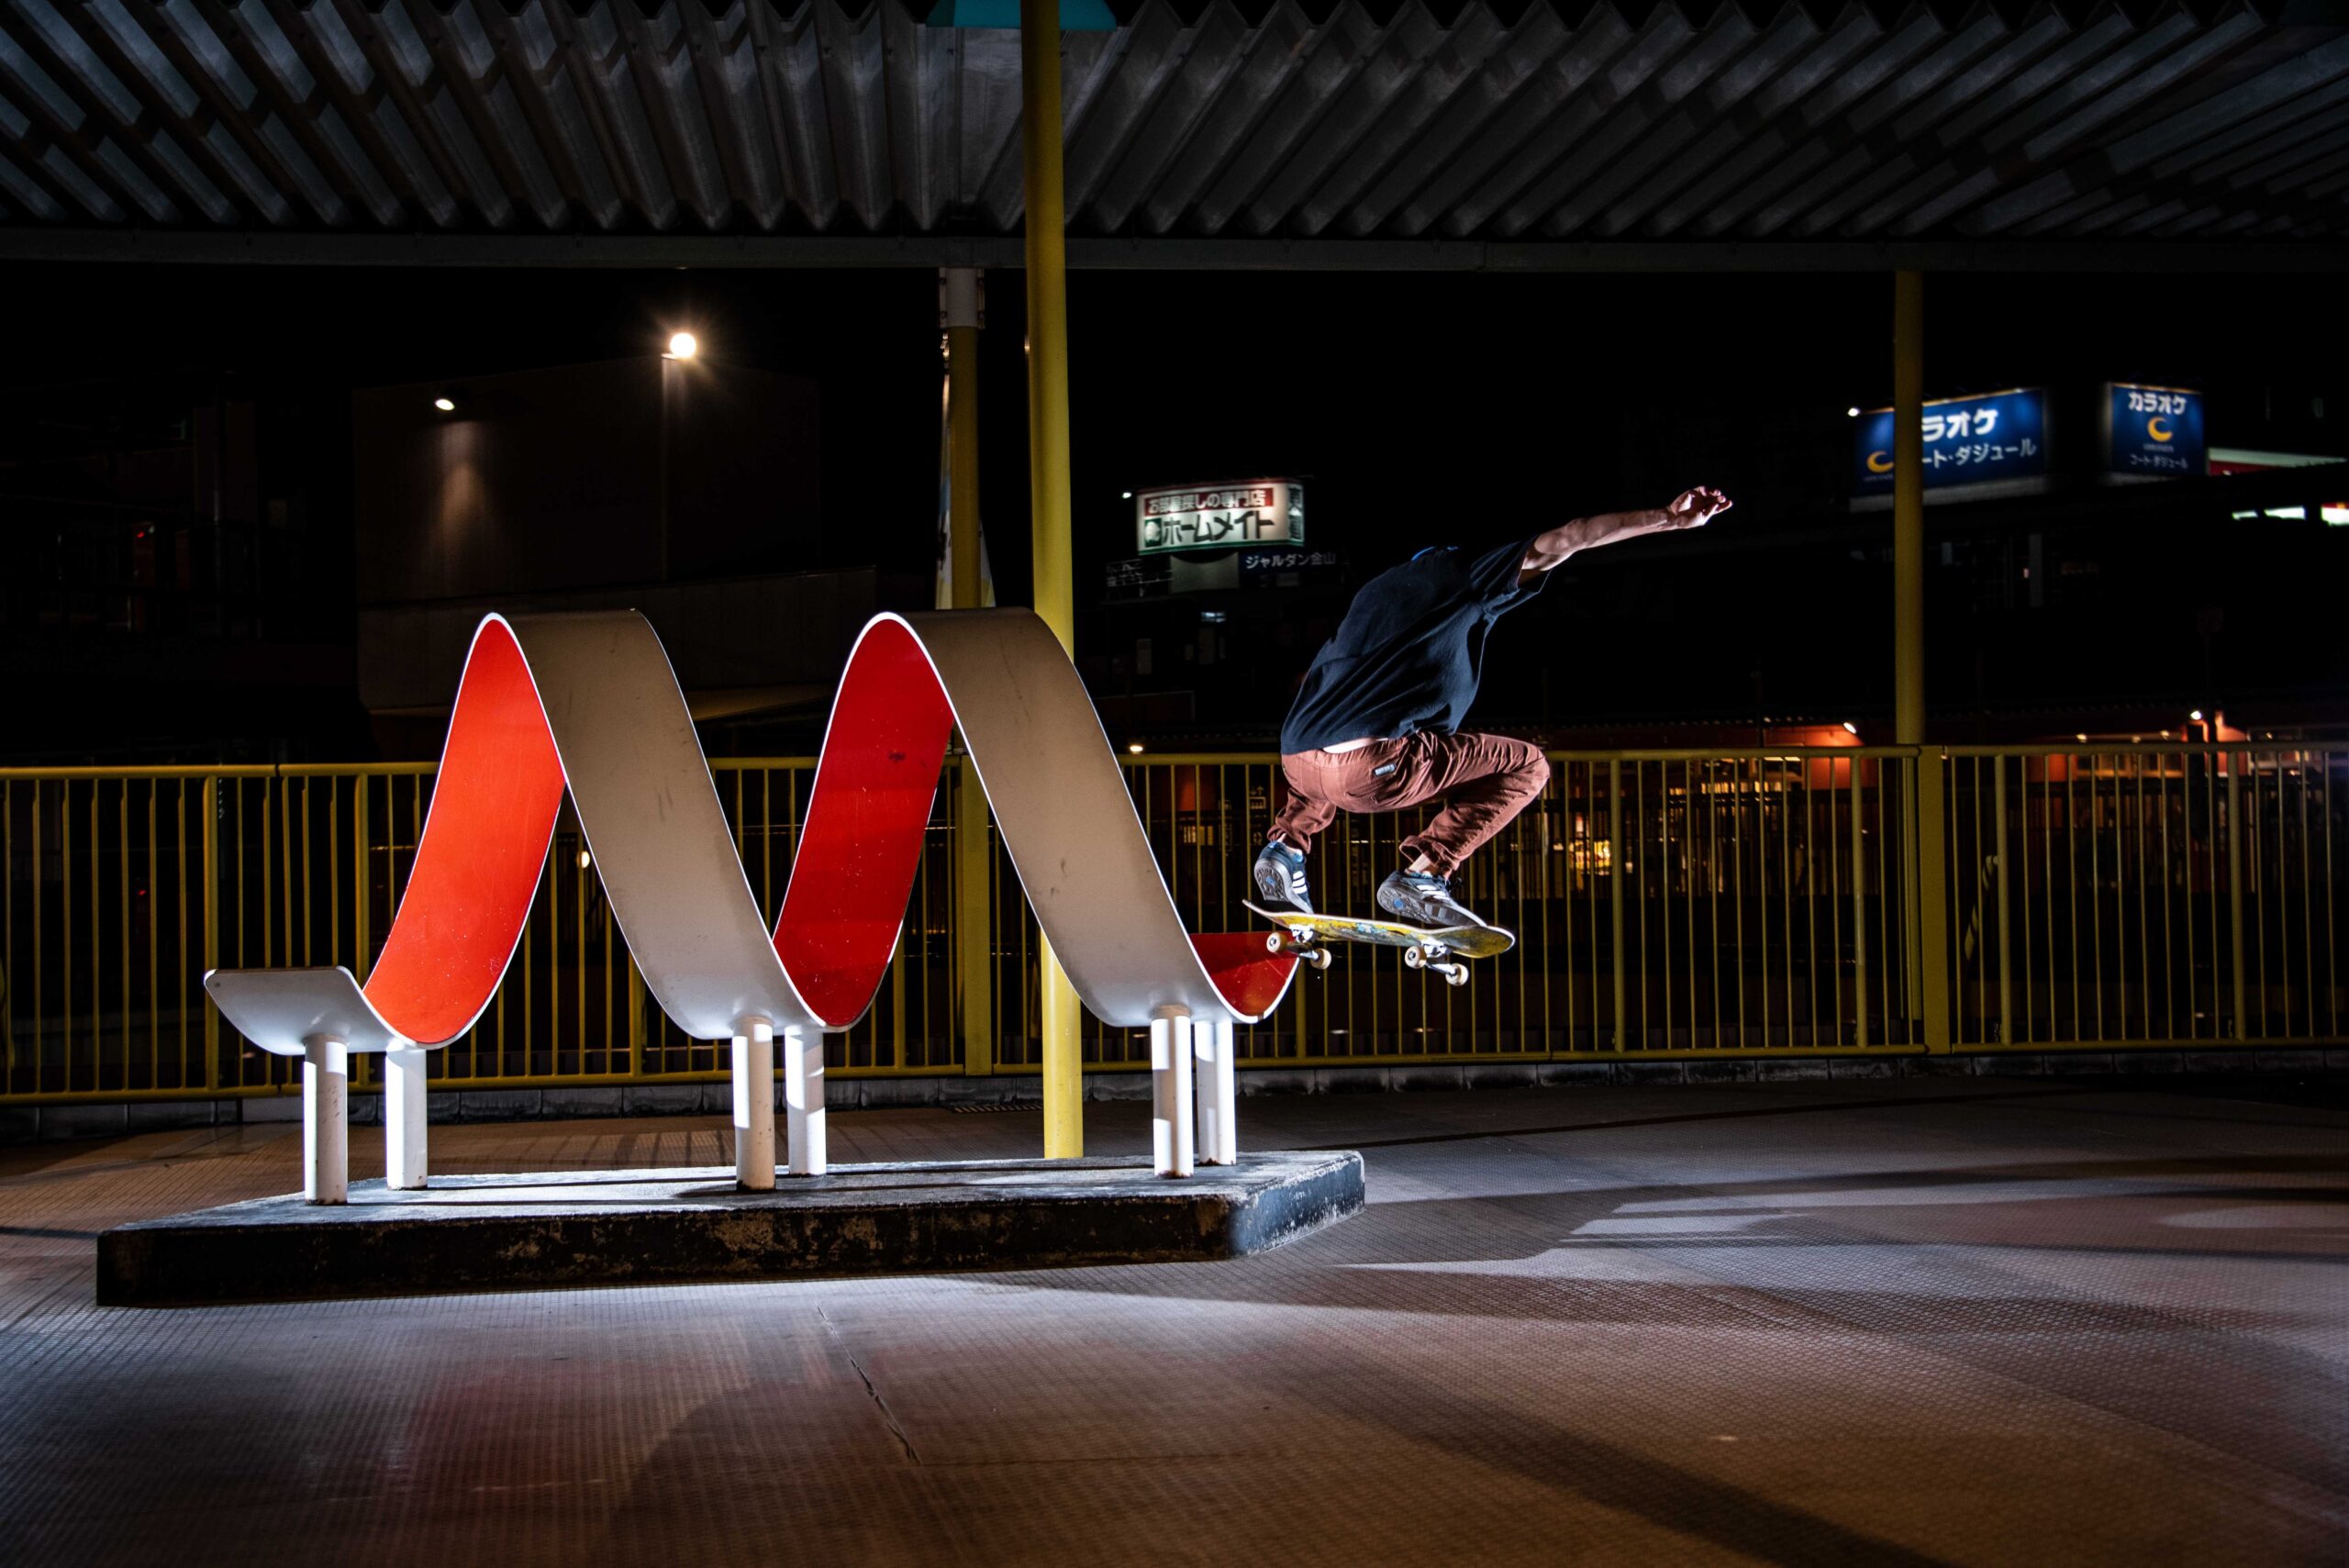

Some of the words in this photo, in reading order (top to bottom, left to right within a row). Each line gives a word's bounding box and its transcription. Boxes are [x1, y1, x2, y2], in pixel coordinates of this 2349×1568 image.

[2127, 391, 2188, 416] カラオケ
[1921, 407, 1998, 442] ラオケ
[1921, 438, 2038, 469] ート・ダジュール
[1163, 510, 1275, 544] ホームメイト
[1245, 551, 1336, 569] ジャルダン金山
